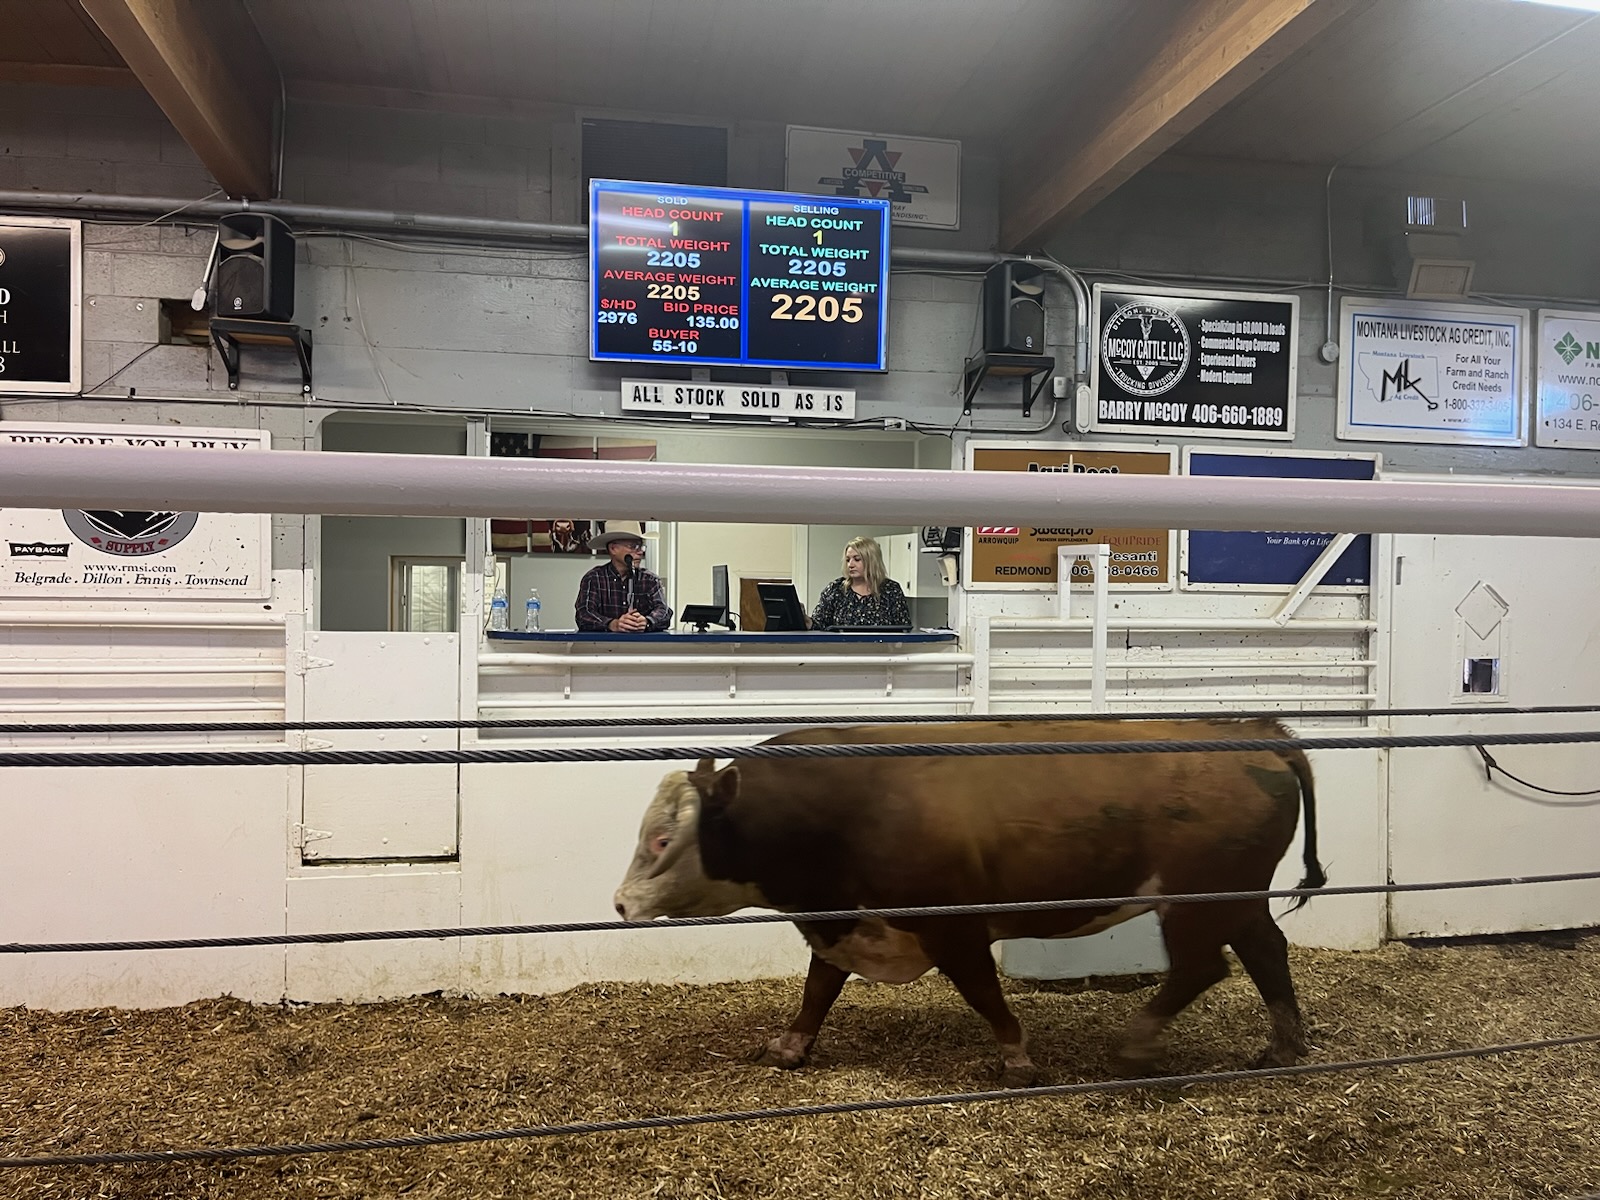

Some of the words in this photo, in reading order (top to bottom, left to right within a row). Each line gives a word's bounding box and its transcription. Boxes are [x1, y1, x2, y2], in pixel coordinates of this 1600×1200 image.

[844, 168, 904, 180] COMPETITIVE
[657, 196, 688, 205] SOLD
[622, 206, 665, 218] HEAD
[669, 210, 724, 222] COUNT
[793, 205, 839, 215] SELLING
[669, 221, 678, 236] 1
[766, 216, 807, 228] HEAD
[810, 218, 863, 231] COUNT
[616, 236, 666, 248] TOTAL
[670, 240, 730, 252] WEIGHT
[813, 230, 823, 245] 1
[759, 244, 808, 257] TOTAL
[811, 248, 869, 260] WEIGHT
[647, 251, 701, 268] 2205
[788, 259, 847, 276] 2205
[604, 270, 675, 282] AVERAGE
[678, 274, 736, 286] WEIGHT
[646, 284, 700, 301] 2205
[750, 278, 819, 290] AVERAGE
[822, 281, 878, 293] WEIGHT
[600, 298, 637, 310] $/HD
[664, 302, 690, 313] BID
[694, 304, 738, 315] PRICE
[770, 294, 864, 323] 2205
[598, 311, 638, 324] 2976
[686, 316, 739, 330] 135.00
[648, 328, 700, 340] BUYER
[1236, 320, 1242, 334] in
[1269, 322, 1286, 336] loads
[1356, 320, 1398, 340] MONTANA
[1400, 324, 1447, 343] LIVESTOCK
[1450, 327, 1461, 344] AG
[1462, 328, 1494, 349] CREDIT,
[1495, 331, 1512, 348] INC.
[0, 340, 20, 354] LL
[652, 340, 698, 353] 55-10
[1108, 338, 1137, 358] McCOY
[1168, 341, 1184, 361] LLC
[1253, 338, 1280, 353] Coverage
[1372, 350, 1397, 358] Montana
[1456, 354, 1469, 364] For
[1470, 355, 1481, 364] All
[1482, 356, 1501, 366] Your
[1118, 368, 1146, 390] TRUCKING
[1148, 370, 1176, 390] DIVISION
[1446, 366, 1466, 376] Farm
[1468, 369, 1482, 378] and
[1484, 370, 1509, 379] Ranch
[1452, 380, 1476, 390] Credit
[1478, 382, 1502, 392] Needs
[633, 386, 662, 403] ALL
[675, 388, 724, 406] STOCK
[741, 390, 780, 408] SOLD
[795, 393, 814, 410] AS
[826, 394, 843, 412] IS
[1100, 400, 1142, 420] BARRY
[1144, 402, 1188, 423] McCOY
[1192, 404, 1283, 426] 406-660-1889
[1554, 418, 1572, 429] 134
[1576, 419, 1586, 430] E.
[106, 540, 155, 553] SUPPLY
[1266, 536, 1281, 545] Your
[1283, 537, 1300, 545] Bank
[1302, 538, 1310, 547] of
[1316, 538, 1332, 547] Life
[14, 546, 64, 554] PAYBACK
[84, 563, 177, 572] www.rmsi.com
[995, 566, 1052, 575] REDMOND
[14, 572, 72, 586] Belgrade
[82, 572, 123, 584] Dillon
[134, 574, 171, 586] Ennis
[185, 574, 248, 586] Townsend
